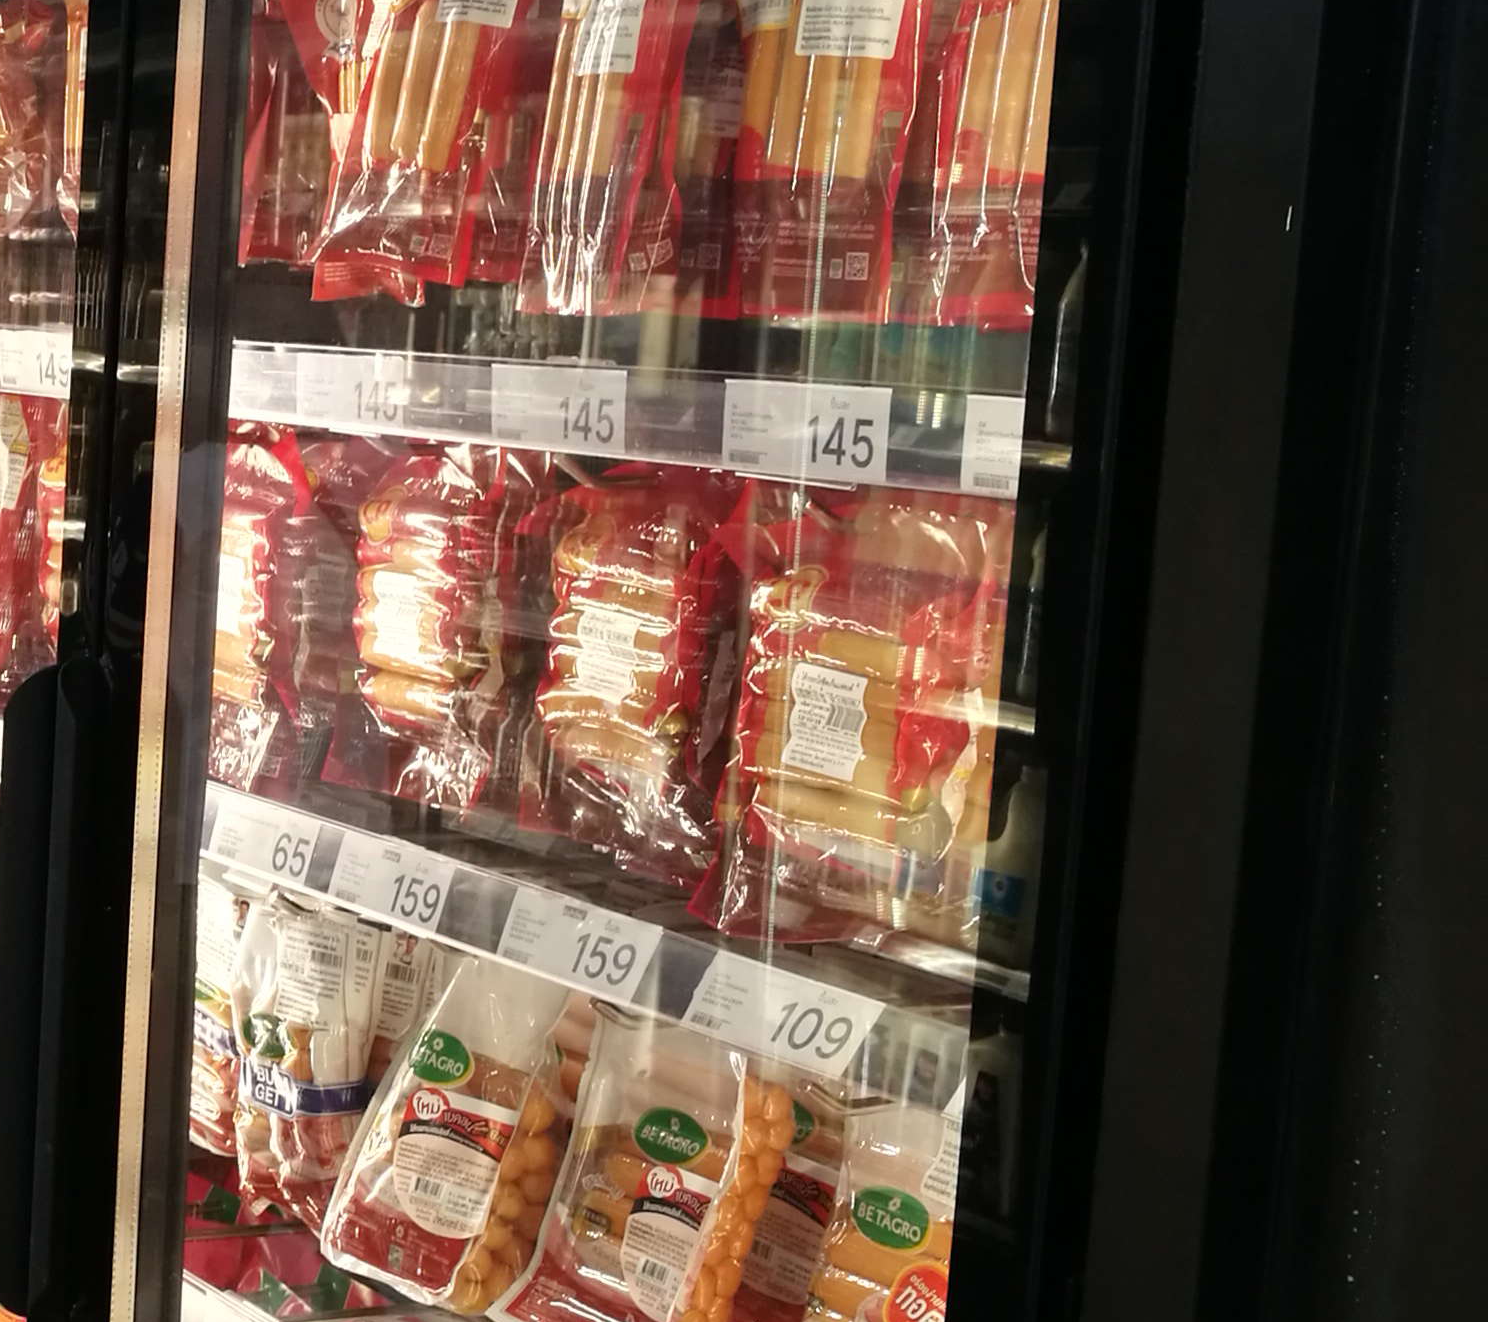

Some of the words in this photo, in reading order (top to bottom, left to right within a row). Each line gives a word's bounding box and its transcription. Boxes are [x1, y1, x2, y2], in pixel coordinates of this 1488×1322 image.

[559, 396, 614, 444] 145
[808, 417, 874, 468] 145
[273, 833, 311, 880] 65
[392, 873, 441, 924] 159
[571, 931, 637, 987] 159
[771, 1001, 853, 1060] 109
[256, 1065, 292, 1089] BU
[415, 1048, 464, 1077] ETAGRO
[640, 1125, 700, 1156] BETAGRO
[647, 1169, 675, 1194] ใหม่
[856, 1201, 922, 1243] BETAGRO
